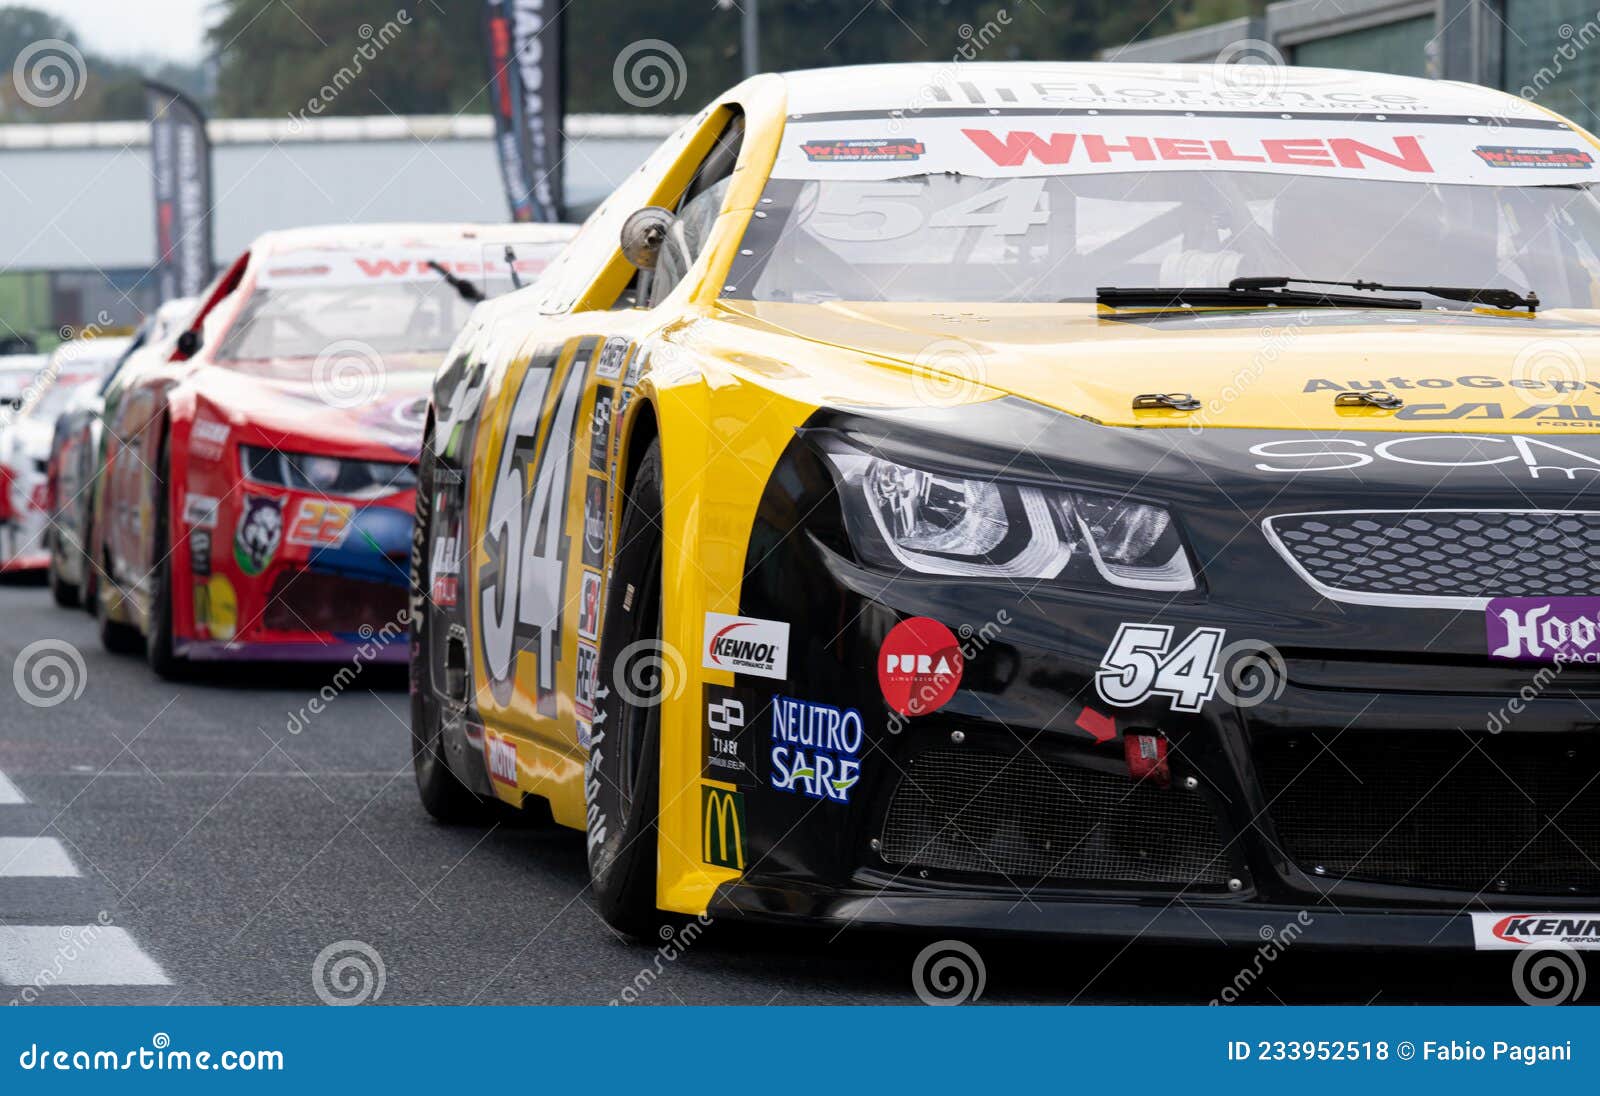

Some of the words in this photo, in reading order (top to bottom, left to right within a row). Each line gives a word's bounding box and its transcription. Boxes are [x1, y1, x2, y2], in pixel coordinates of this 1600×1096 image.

[801, 143, 924, 156] WHELEN
[961, 129, 1435, 173] WHELEN
[812, 177, 1050, 241] 54
[291, 503, 352, 544] 22
[478, 350, 594, 710] 54
[714, 637, 776, 664] KENNOL
[886, 654, 952, 674] PURA
[1095, 622, 1224, 713] 54
[772, 697, 862, 753] NEUTRO
